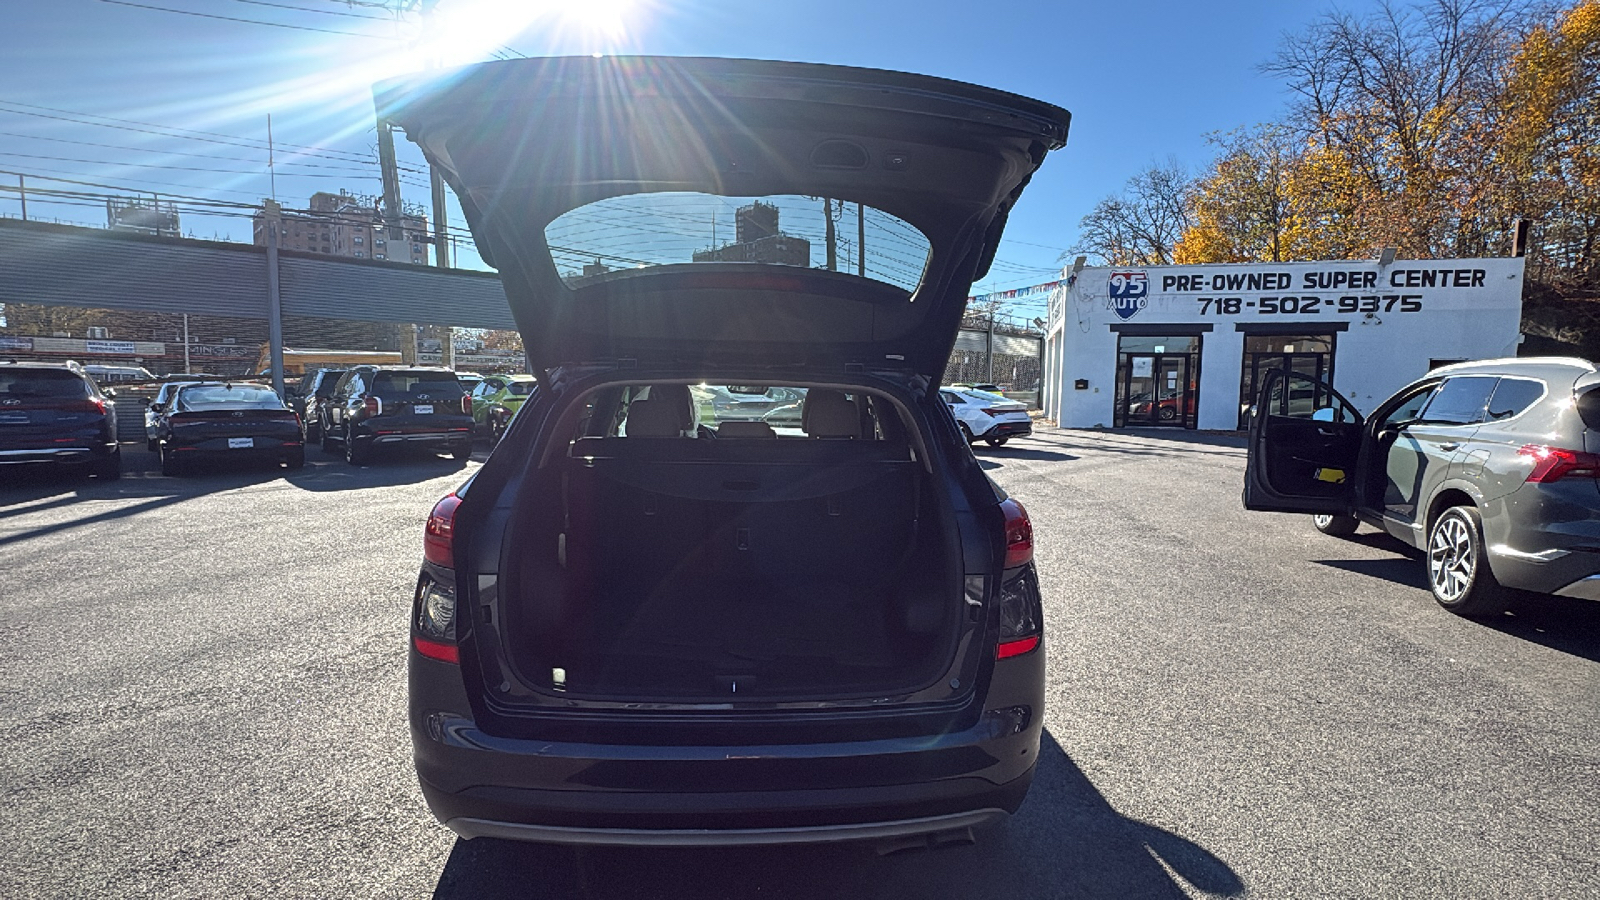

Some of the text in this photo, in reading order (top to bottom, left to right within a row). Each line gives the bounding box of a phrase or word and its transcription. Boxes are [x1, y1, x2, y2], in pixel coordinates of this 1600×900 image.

[1110, 274, 1146, 295] 95
[1162, 269, 1486, 292] PRE-OWNED SUPER CENTER
[1106, 296, 1148, 310] AUTO
[1197, 294, 1423, 316] 718-502-9375
